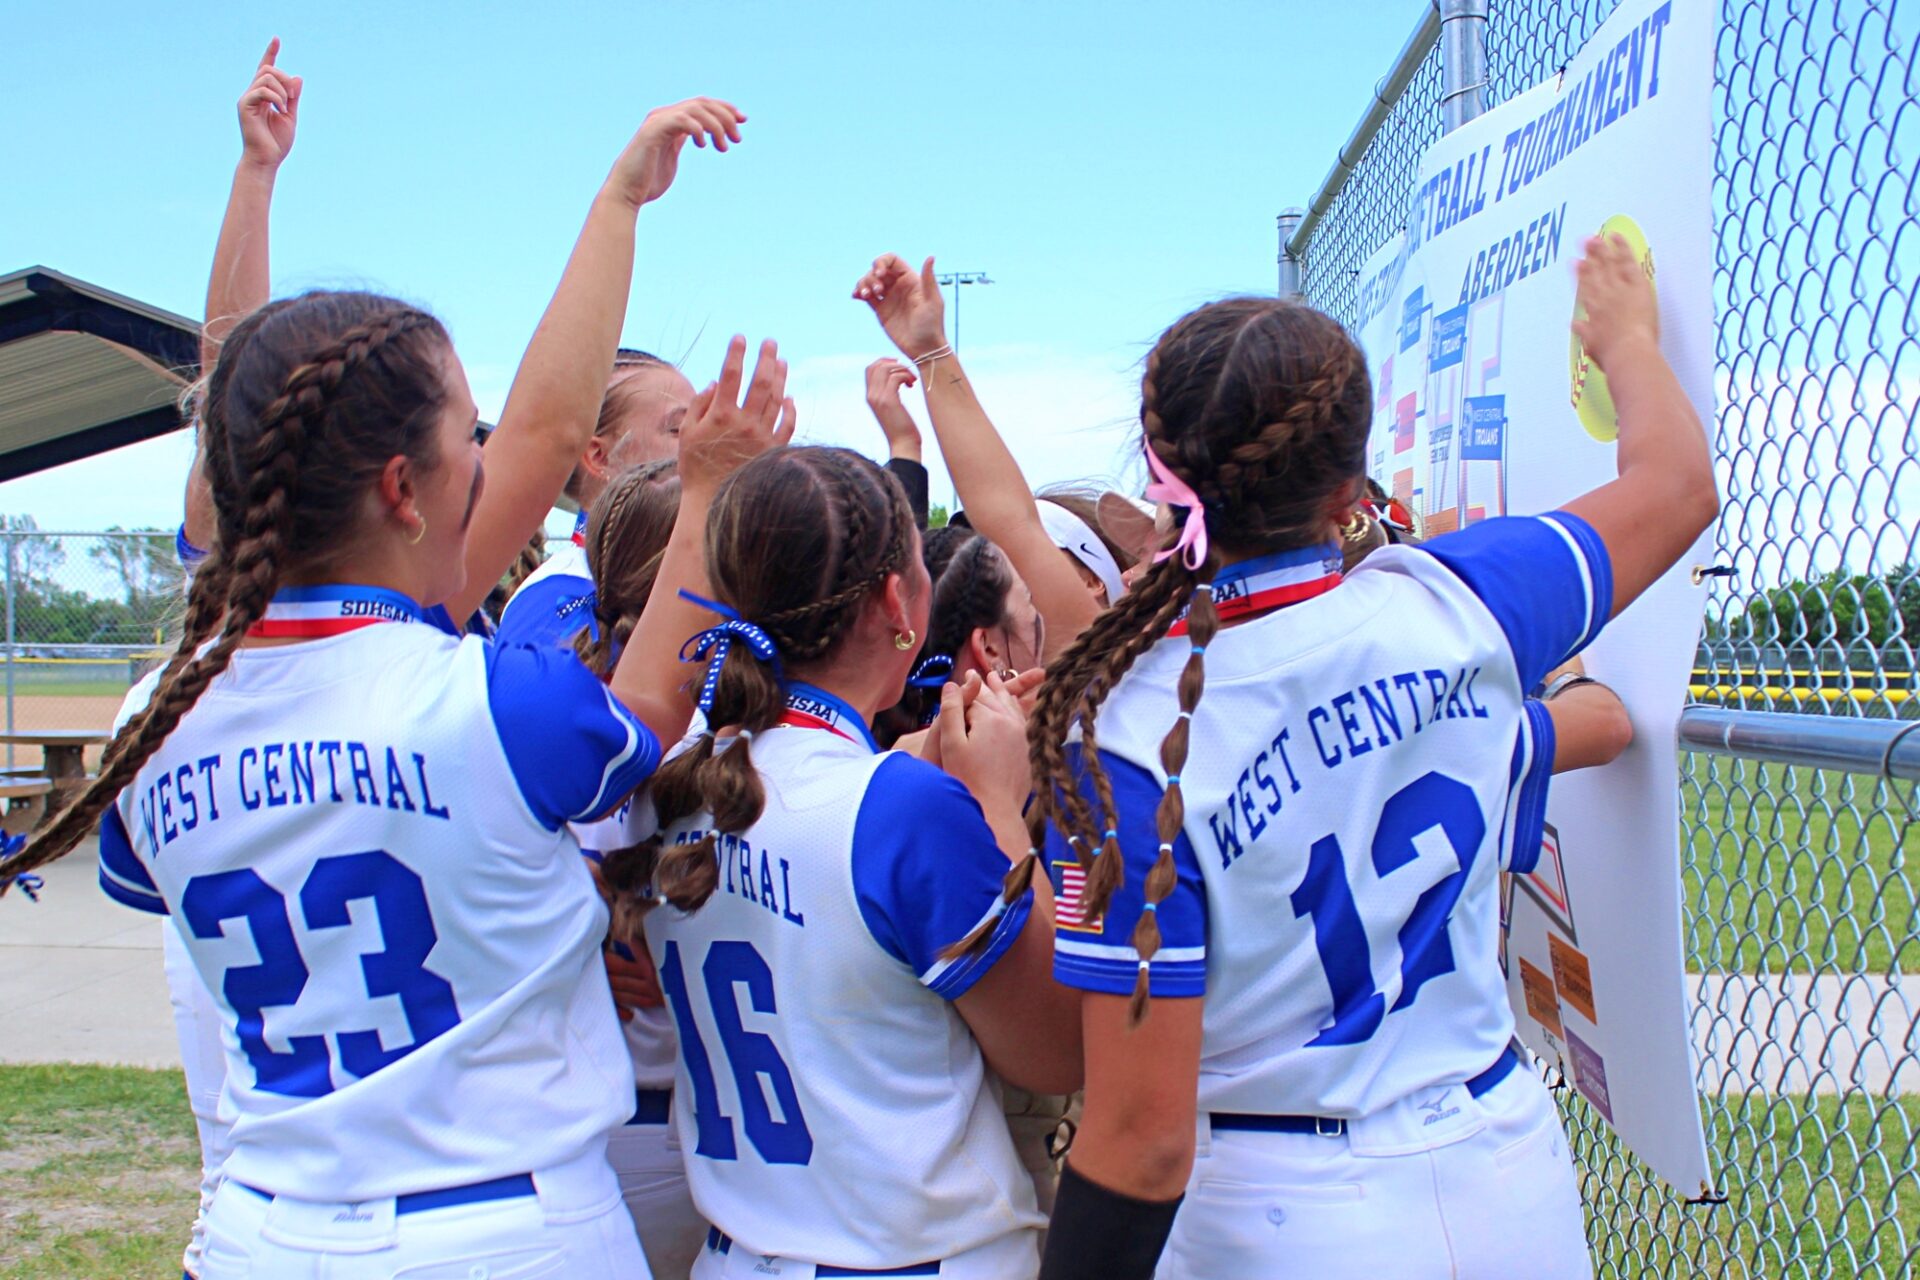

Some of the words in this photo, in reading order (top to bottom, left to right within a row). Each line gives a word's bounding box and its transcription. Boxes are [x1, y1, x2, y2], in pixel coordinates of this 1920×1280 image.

[1495, 0, 1673, 204] TOURNAMENT
[1458, 201, 1567, 304] ABERDEEN
[141, 754, 221, 859] WEST
[238, 741, 450, 821] CENTRAL
[1208, 727, 1302, 872] WEST
[1307, 667, 1488, 769] CENTRAL
[181, 849, 462, 1099] 23
[1290, 770, 1488, 1048] 12
[659, 940, 814, 1167] 16
